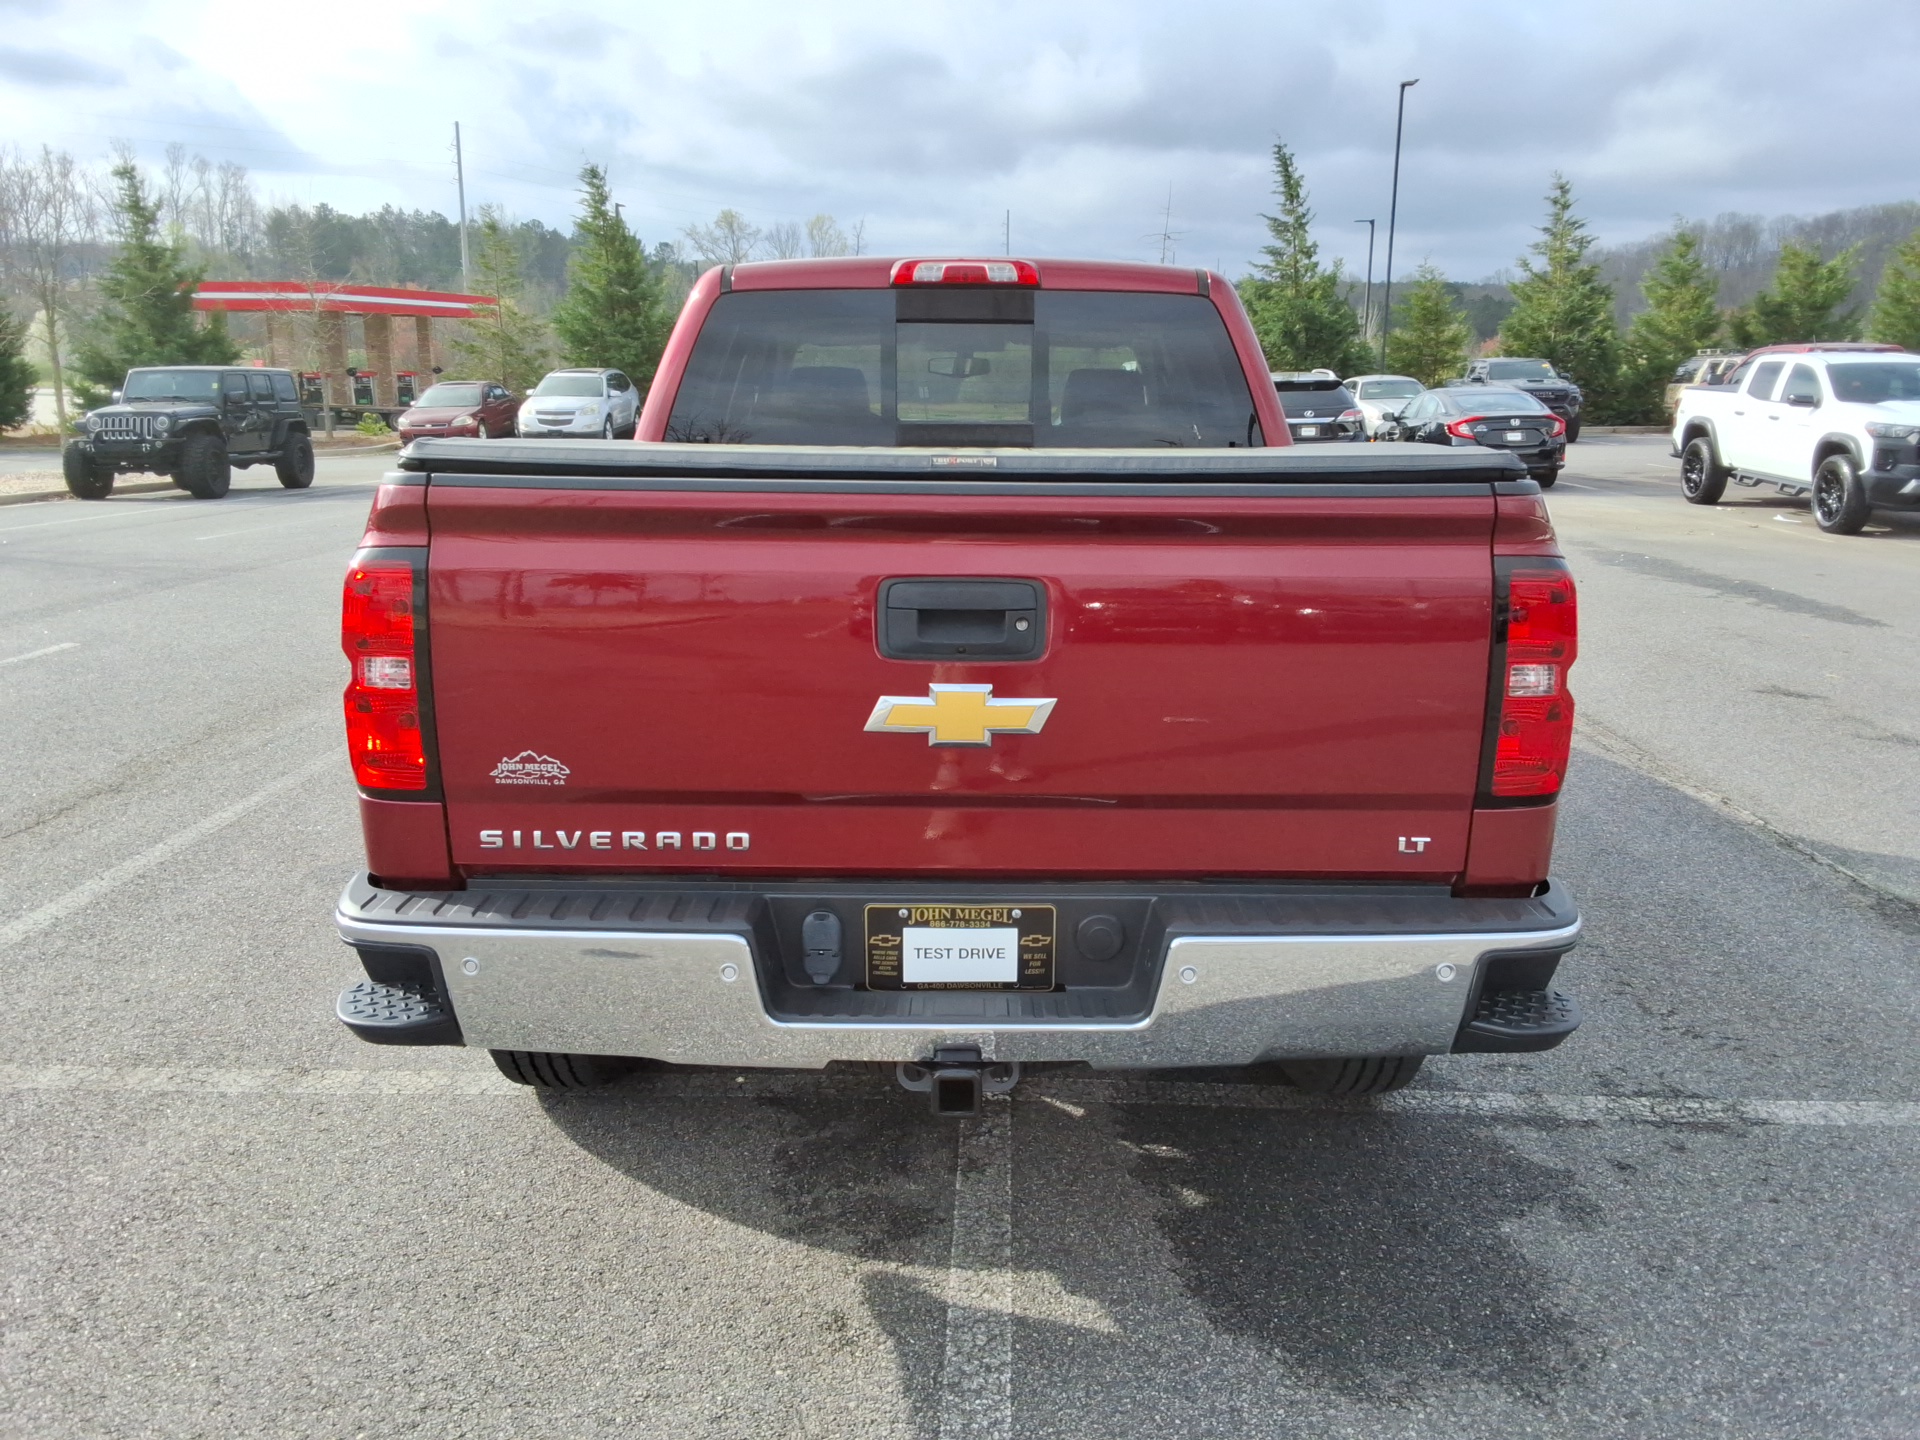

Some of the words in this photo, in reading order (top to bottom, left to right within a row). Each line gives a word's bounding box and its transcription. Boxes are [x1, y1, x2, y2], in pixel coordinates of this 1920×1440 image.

[497, 762, 523, 773] JOHN
[524, 762, 560, 773] MEGEL
[495, 777, 551, 786] DAWSONVILLE,
[479, 829, 751, 851] SILVERADO
[1398, 836, 1431, 853] LT
[908, 907, 951, 925] JOHN
[955, 907, 1013, 923] MEGEL
[929, 920, 991, 928] 866-778-3334
[914, 947, 953, 960] TEST
[958, 947, 1006, 960] DRIVE
[917, 982, 945, 990] GA-400
